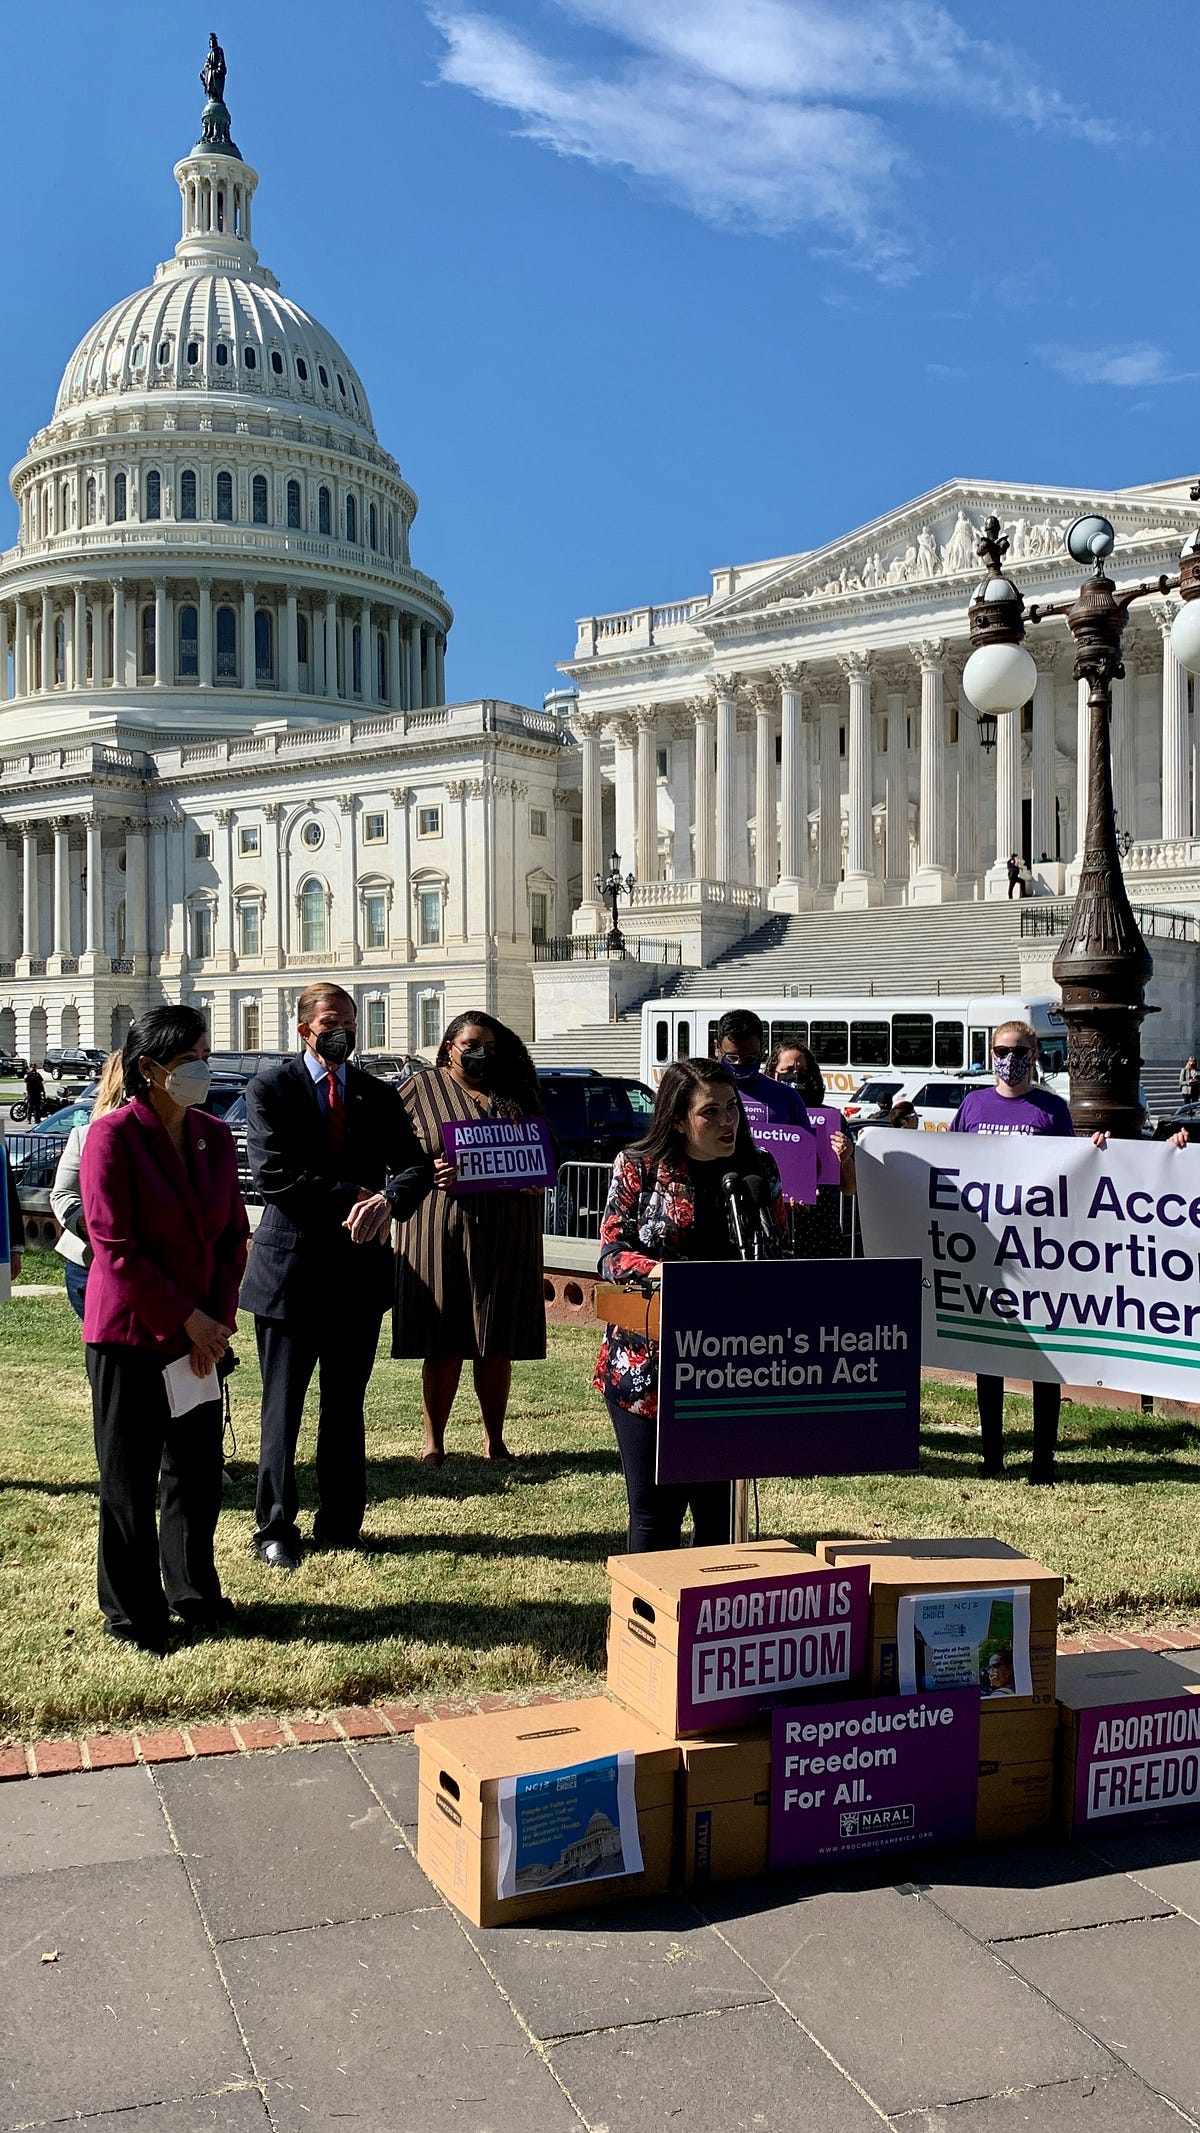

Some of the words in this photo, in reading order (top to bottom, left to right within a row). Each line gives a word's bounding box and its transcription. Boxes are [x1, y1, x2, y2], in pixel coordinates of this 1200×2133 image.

[454, 1124, 524, 1146] ABORTION
[526, 1123, 540, 1141] IS
[460, 1148, 544, 1177] FREEDOM
[928, 1166, 1069, 1223] Equal
[928, 1220, 976, 1263] to
[993, 1225, 1200, 1282] Abortio
[933, 1268, 1200, 1337] Everywher
[675, 1327, 810, 1358] Women's
[819, 1324, 908, 1352] Health
[675, 1359, 822, 1390] Protection
[832, 1357, 879, 1384] Act
[696, 1584, 822, 1635] ABORTION
[828, 1581, 852, 1617] IS
[698, 1630, 847, 1695] FREEDOM
[785, 1704, 954, 1747] Reproductive
[1093, 1707, 1200, 1755] ABORTION
[784, 1747, 897, 1777] Freedom
[1093, 1755, 1199, 1810] FREEDO
[784, 1789, 825, 1811] For
[832, 1779, 873, 1805] All.
[862, 1808, 909, 1826] NARAL
